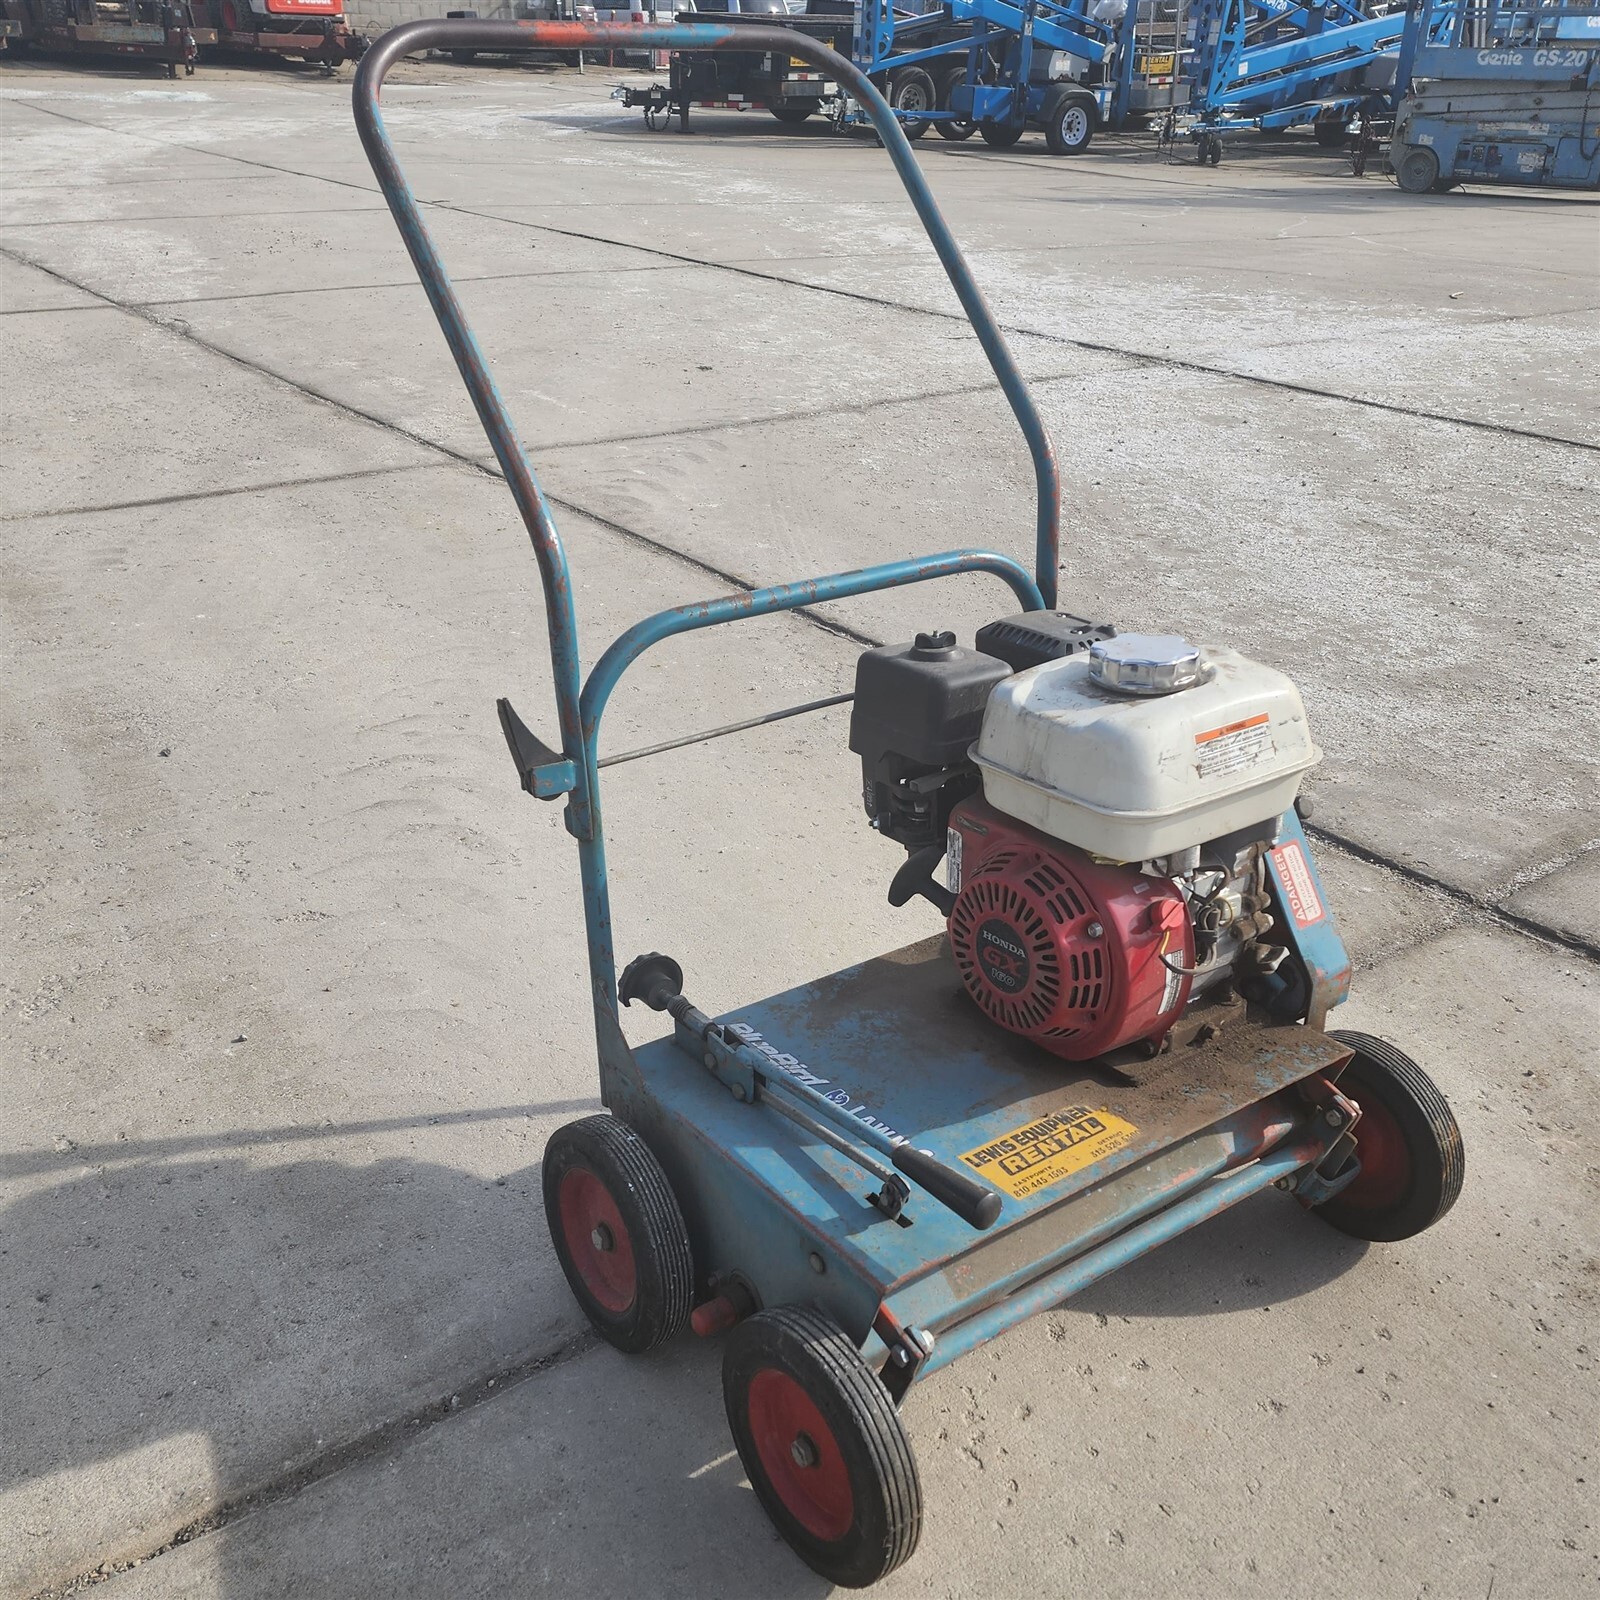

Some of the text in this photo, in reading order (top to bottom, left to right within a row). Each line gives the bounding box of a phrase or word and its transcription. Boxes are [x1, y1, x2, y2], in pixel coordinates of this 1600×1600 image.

[1477, 49, 1523, 66] Genie
[1273, 852, 1302, 910] DANGER
[983, 930, 1026, 958] HONDA
[983, 945, 1025, 976] GX
[991, 968, 1016, 987] 160
[965, 1105, 1094, 1168] LEWIS EQUIPMEN
[1002, 1120, 1105, 1174] RENTAL
[1013, 1165, 1054, 1188] EASTPOINTE
[1013, 1184, 1031, 1199] 810
[1030, 1176, 1048, 1190] 445
